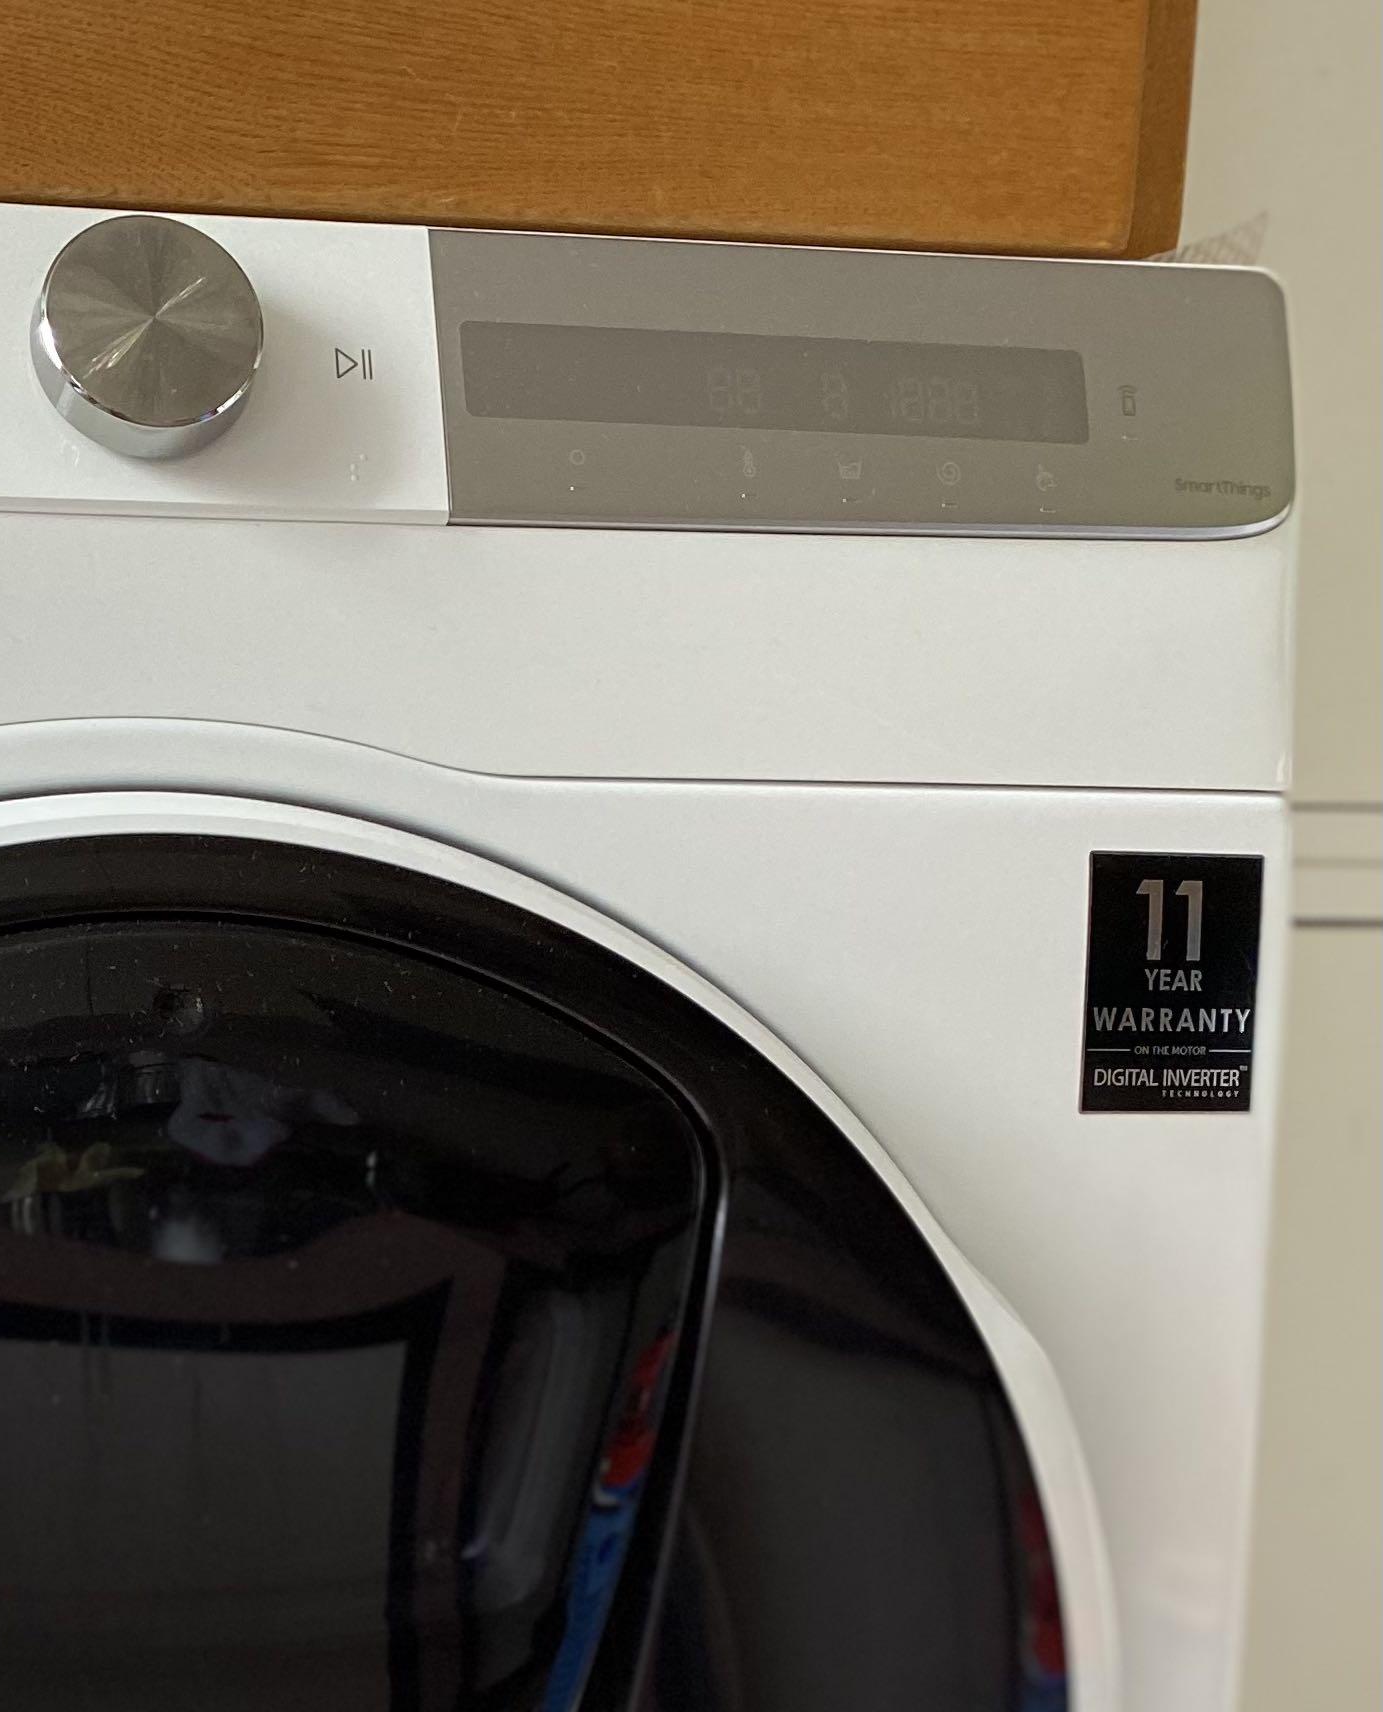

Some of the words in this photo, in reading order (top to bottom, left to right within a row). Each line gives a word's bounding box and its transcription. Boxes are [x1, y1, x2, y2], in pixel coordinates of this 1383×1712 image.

[1175, 478, 1272, 500] SmartThings
[1136, 879, 1203, 961] 11
[1144, 969, 1203, 992] YEAR
[1093, 1007, 1251, 1033] WARRANTY
[1134, 1045, 1150, 1055] ON
[1152, 1045, 1170, 1056] THE
[1172, 1045, 1207, 1056] MOTOR
[1093, 1068, 1158, 1087] DIGITAL
[1162, 1090, 1240, 1098] TECHNOLOGY
